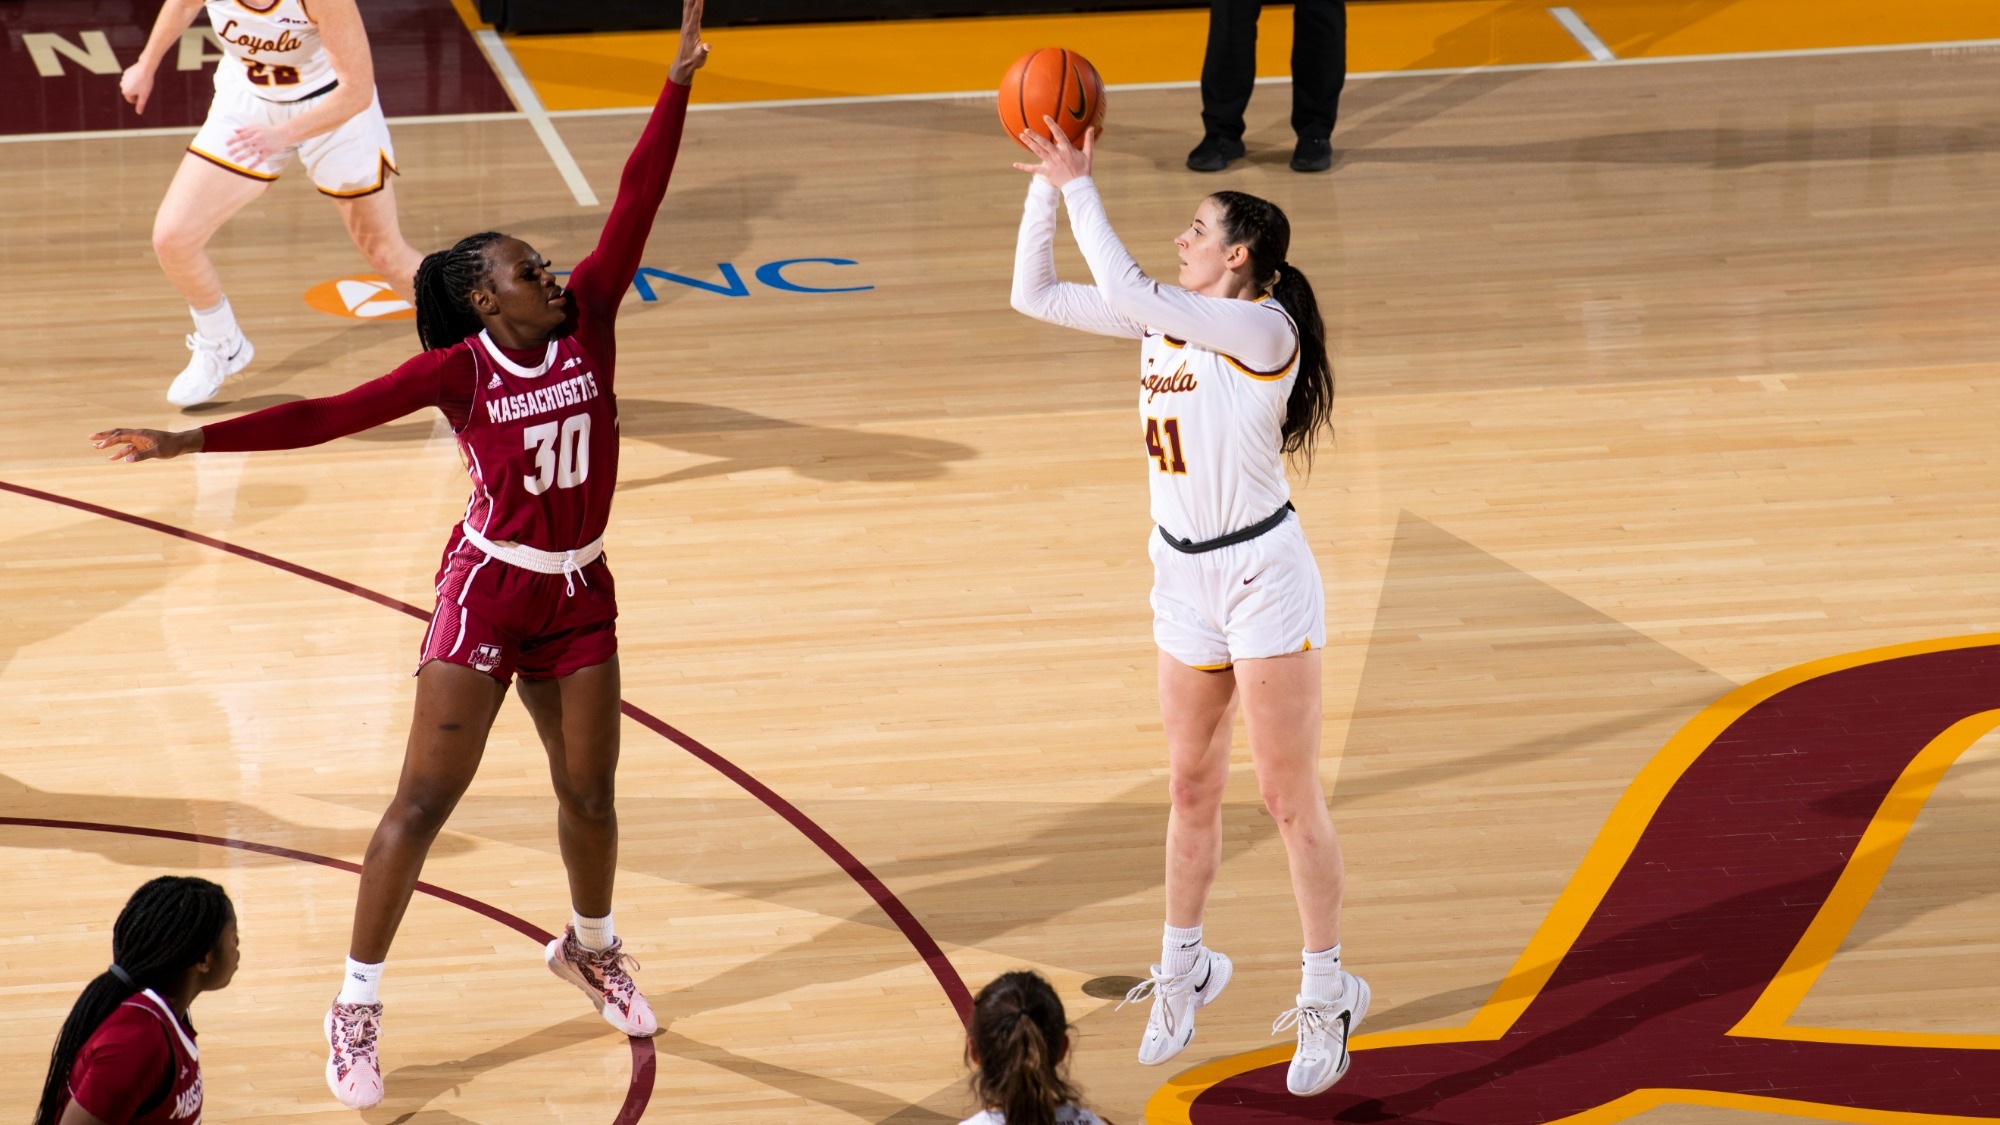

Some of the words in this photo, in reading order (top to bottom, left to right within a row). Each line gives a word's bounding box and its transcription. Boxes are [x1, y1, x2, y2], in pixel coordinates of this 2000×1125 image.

[219, 19, 302, 55] Loyola
[553, 257, 876, 302] NC
[523, 412, 592, 496] 30
[1145, 416, 1187, 475] 41
